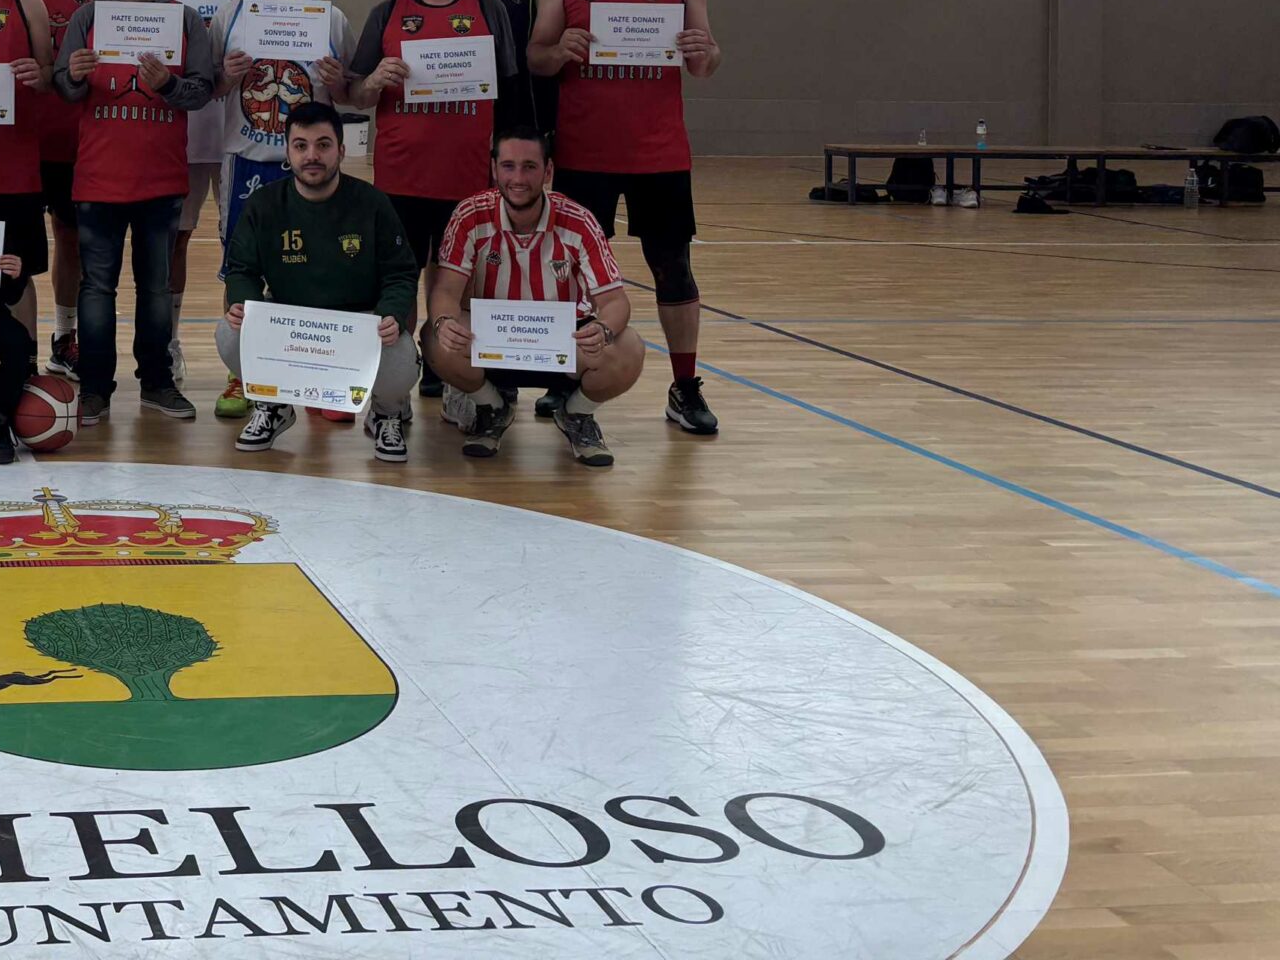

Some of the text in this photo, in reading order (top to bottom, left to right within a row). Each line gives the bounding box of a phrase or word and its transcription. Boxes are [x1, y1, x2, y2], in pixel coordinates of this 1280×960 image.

[111, 14, 165, 24] HAZTE DONANTE
[632, 16, 665, 24] DONANTE
[420, 50, 477, 59] HAZTE DONANTE
[579, 65, 663, 80] CROQUETAS
[95, 105, 173, 123] CROQUETAS
[240, 124, 284, 146] BROTH
[281, 229, 303, 251] 15
[270, 316, 354, 333] HAZTE DONANTE DE
[491, 313, 555, 323] HAZTE DONANTE
[497, 325, 508, 333] DE
[290, 330, 331, 343] ÓRGANOS
